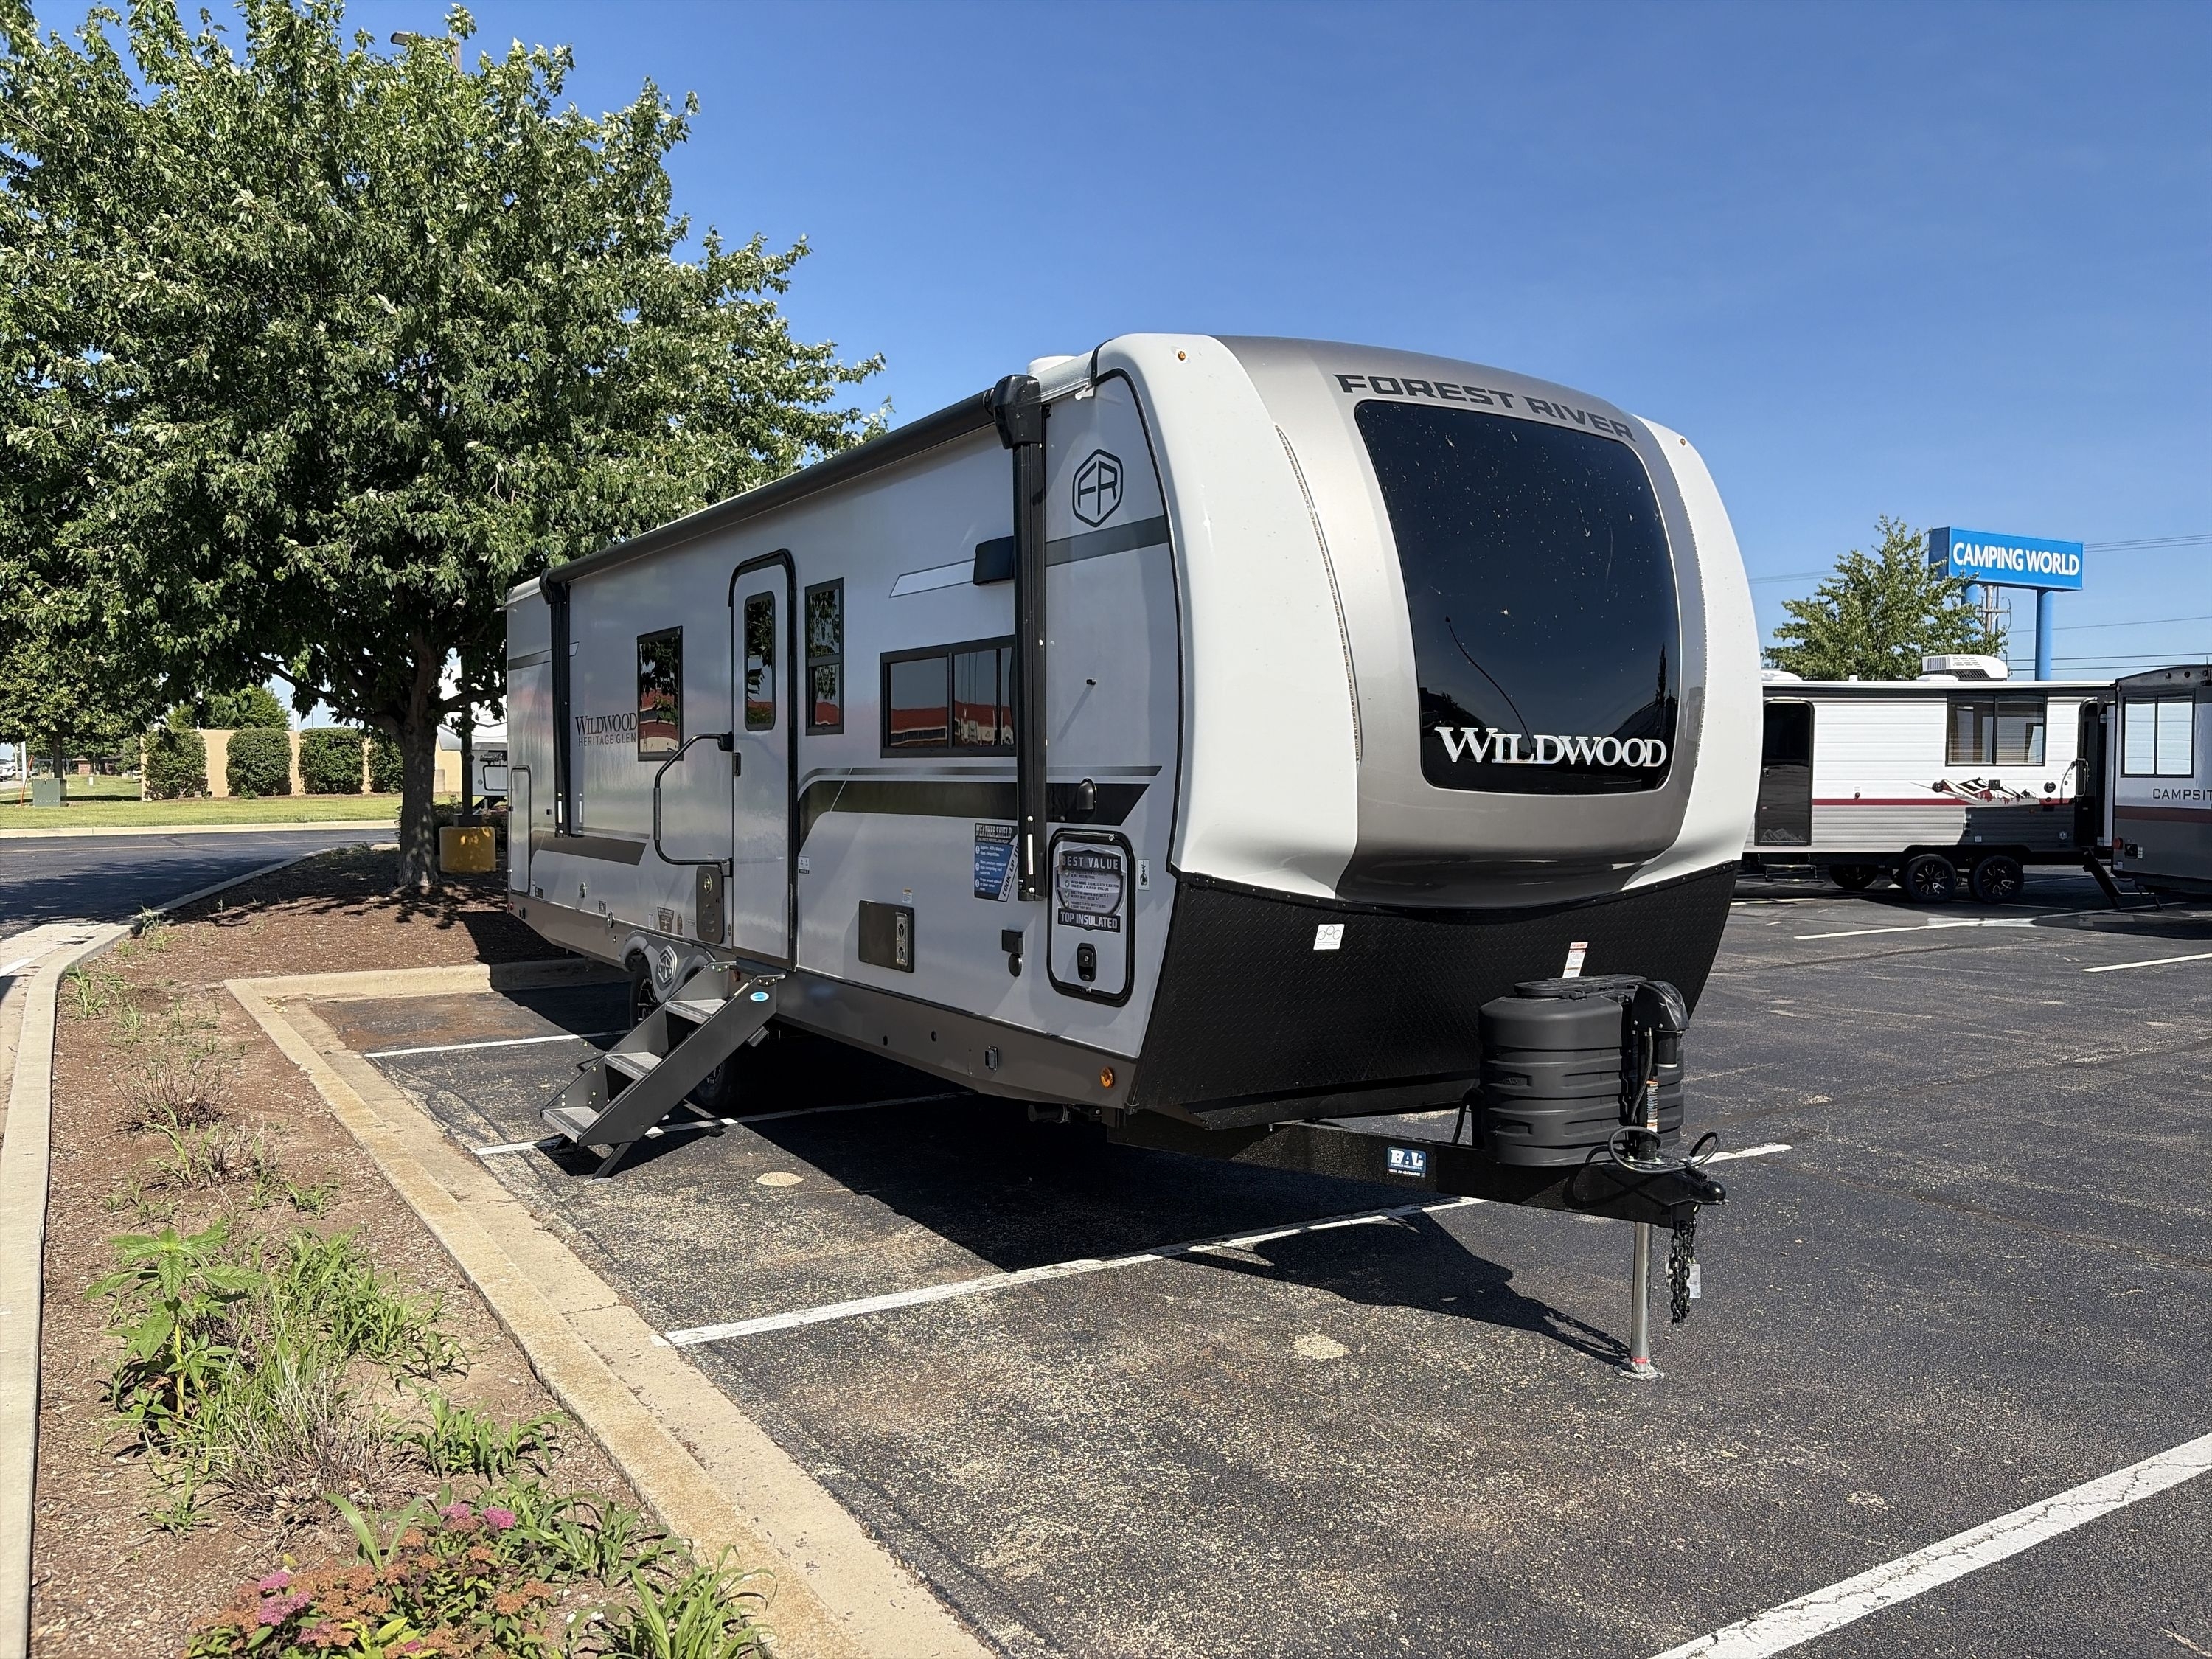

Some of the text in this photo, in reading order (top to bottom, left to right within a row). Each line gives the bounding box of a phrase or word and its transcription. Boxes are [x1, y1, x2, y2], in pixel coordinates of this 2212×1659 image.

[1332, 374, 1636, 442] FOREST RIVER
[1952, 542, 2079, 576] CAMPING WORLD
[579, 732, 636, 747] HERITAGE GLEN
[975, 824, 1012, 839] WEATHER SHIELD
[1062, 855, 1119, 871] BEST VALUE
[1002, 875, 1012, 897] LOOK
[1009, 860, 1015, 873] UP
[1060, 911, 1118, 929] TOP INSULATED
